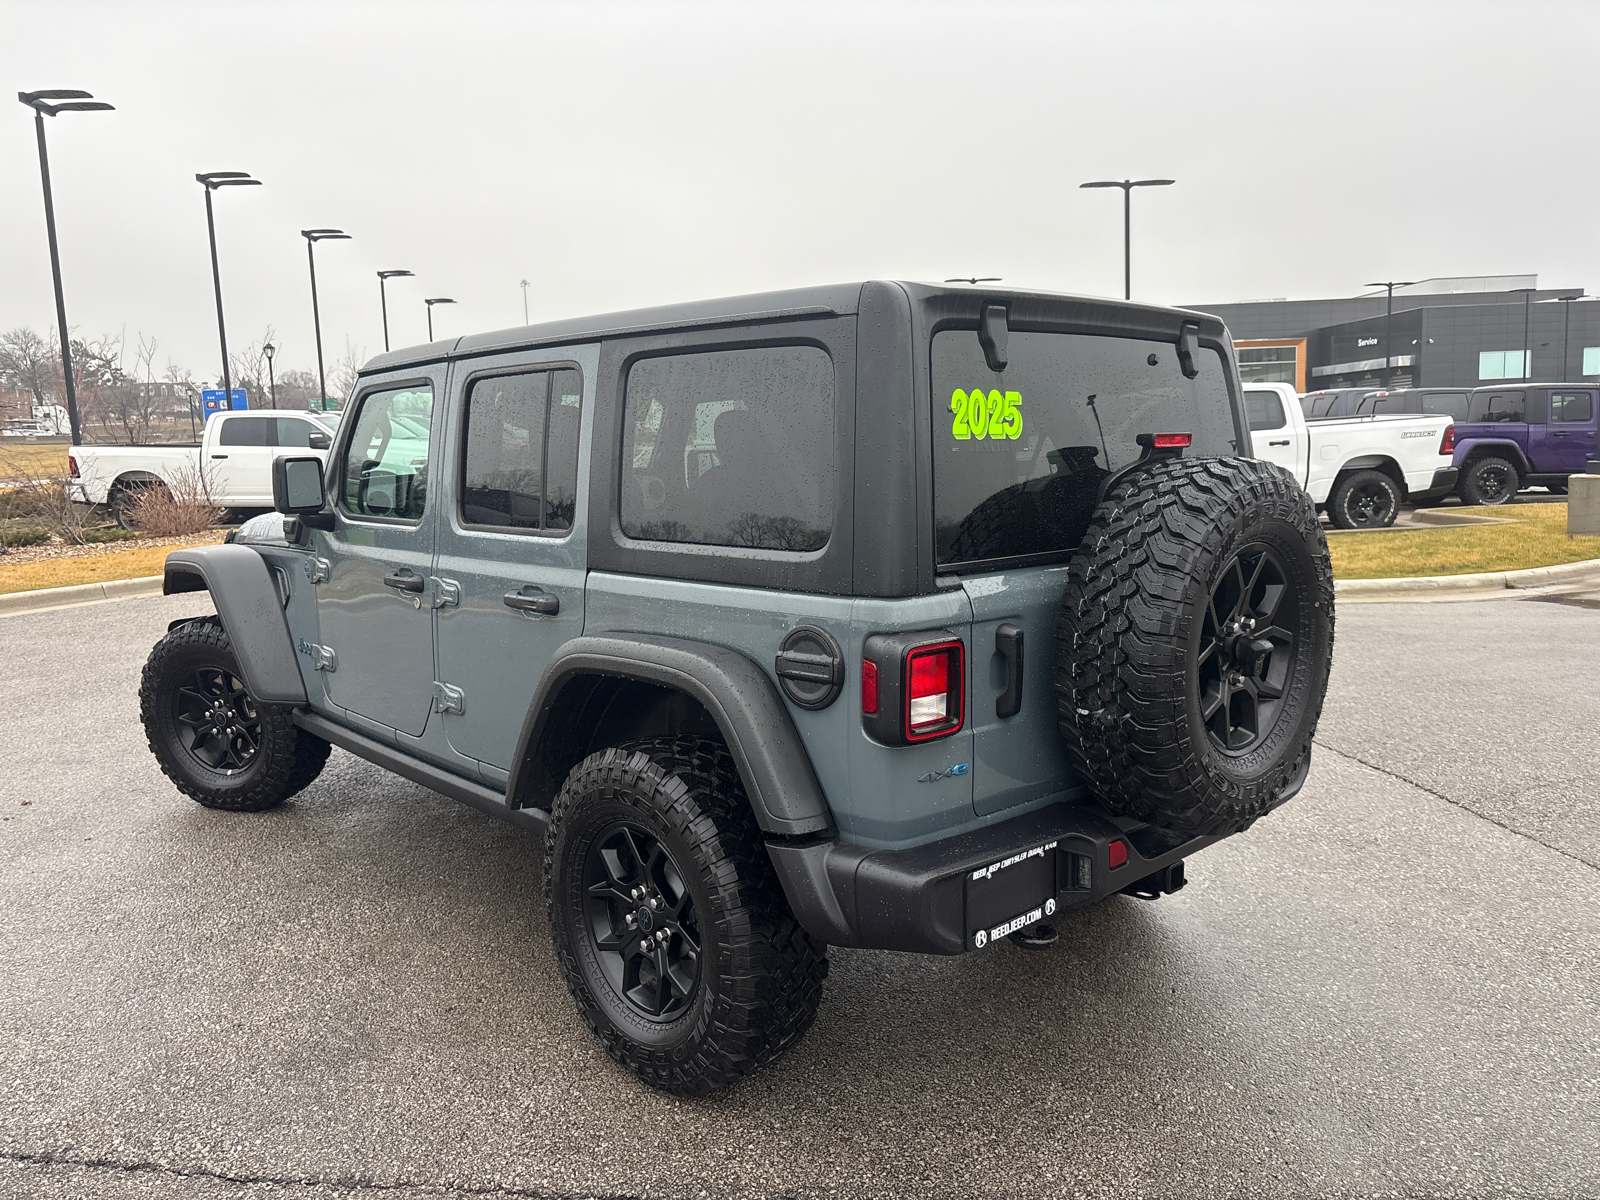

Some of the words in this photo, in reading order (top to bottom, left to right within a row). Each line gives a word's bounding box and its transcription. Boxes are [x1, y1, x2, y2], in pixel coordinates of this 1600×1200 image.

[1357, 337, 1378, 347] Service
[951, 389, 1023, 440] 2025
[570, 786, 672, 836] FALKEN
[973, 868, 986, 880] REED
[1001, 852, 1027, 868] CHRYSLER
[1045, 841, 1057, 850] RAM
[991, 908, 1041, 941] REEDJEEP.COM
